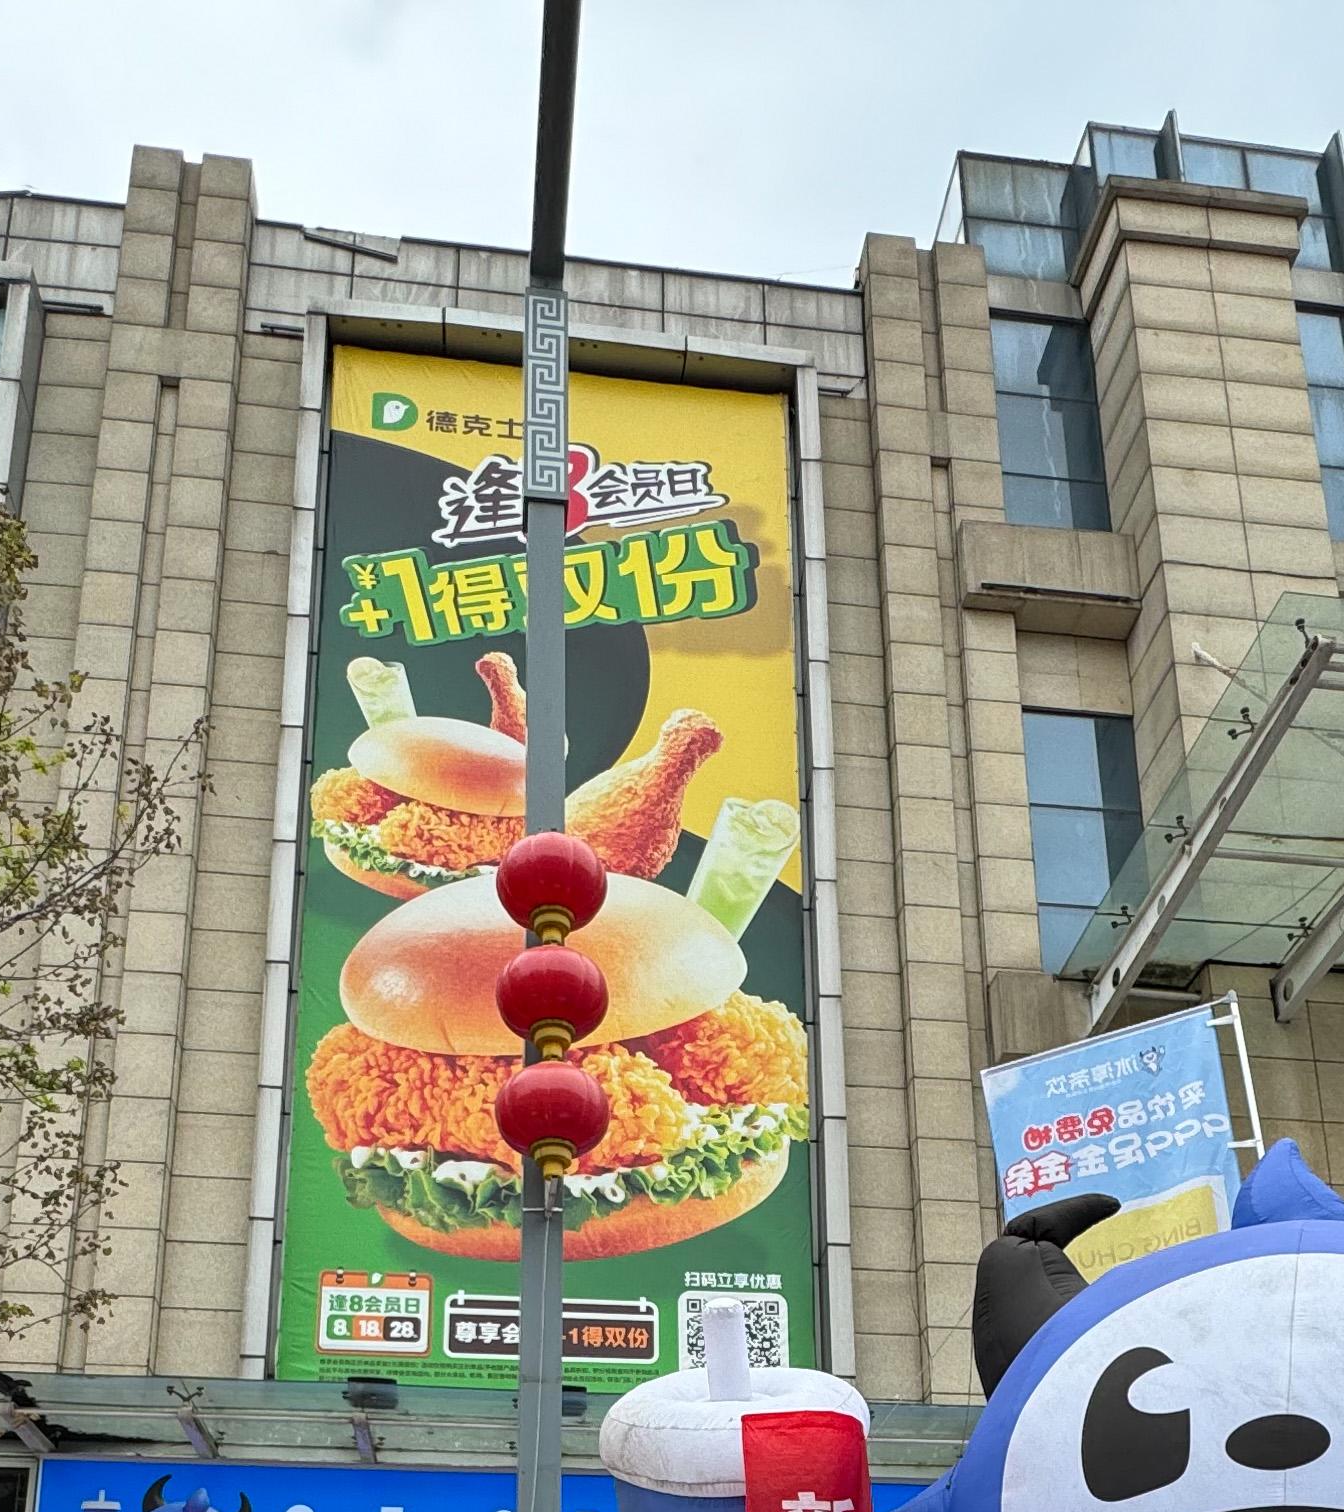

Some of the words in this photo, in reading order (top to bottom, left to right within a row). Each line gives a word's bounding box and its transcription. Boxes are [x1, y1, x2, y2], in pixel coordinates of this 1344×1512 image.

[425, 409, 525, 439] 德克士
[683, 1270, 784, 1291] 扫码立享优惠
[328, 1293, 422, 1316] 逢8会员日
